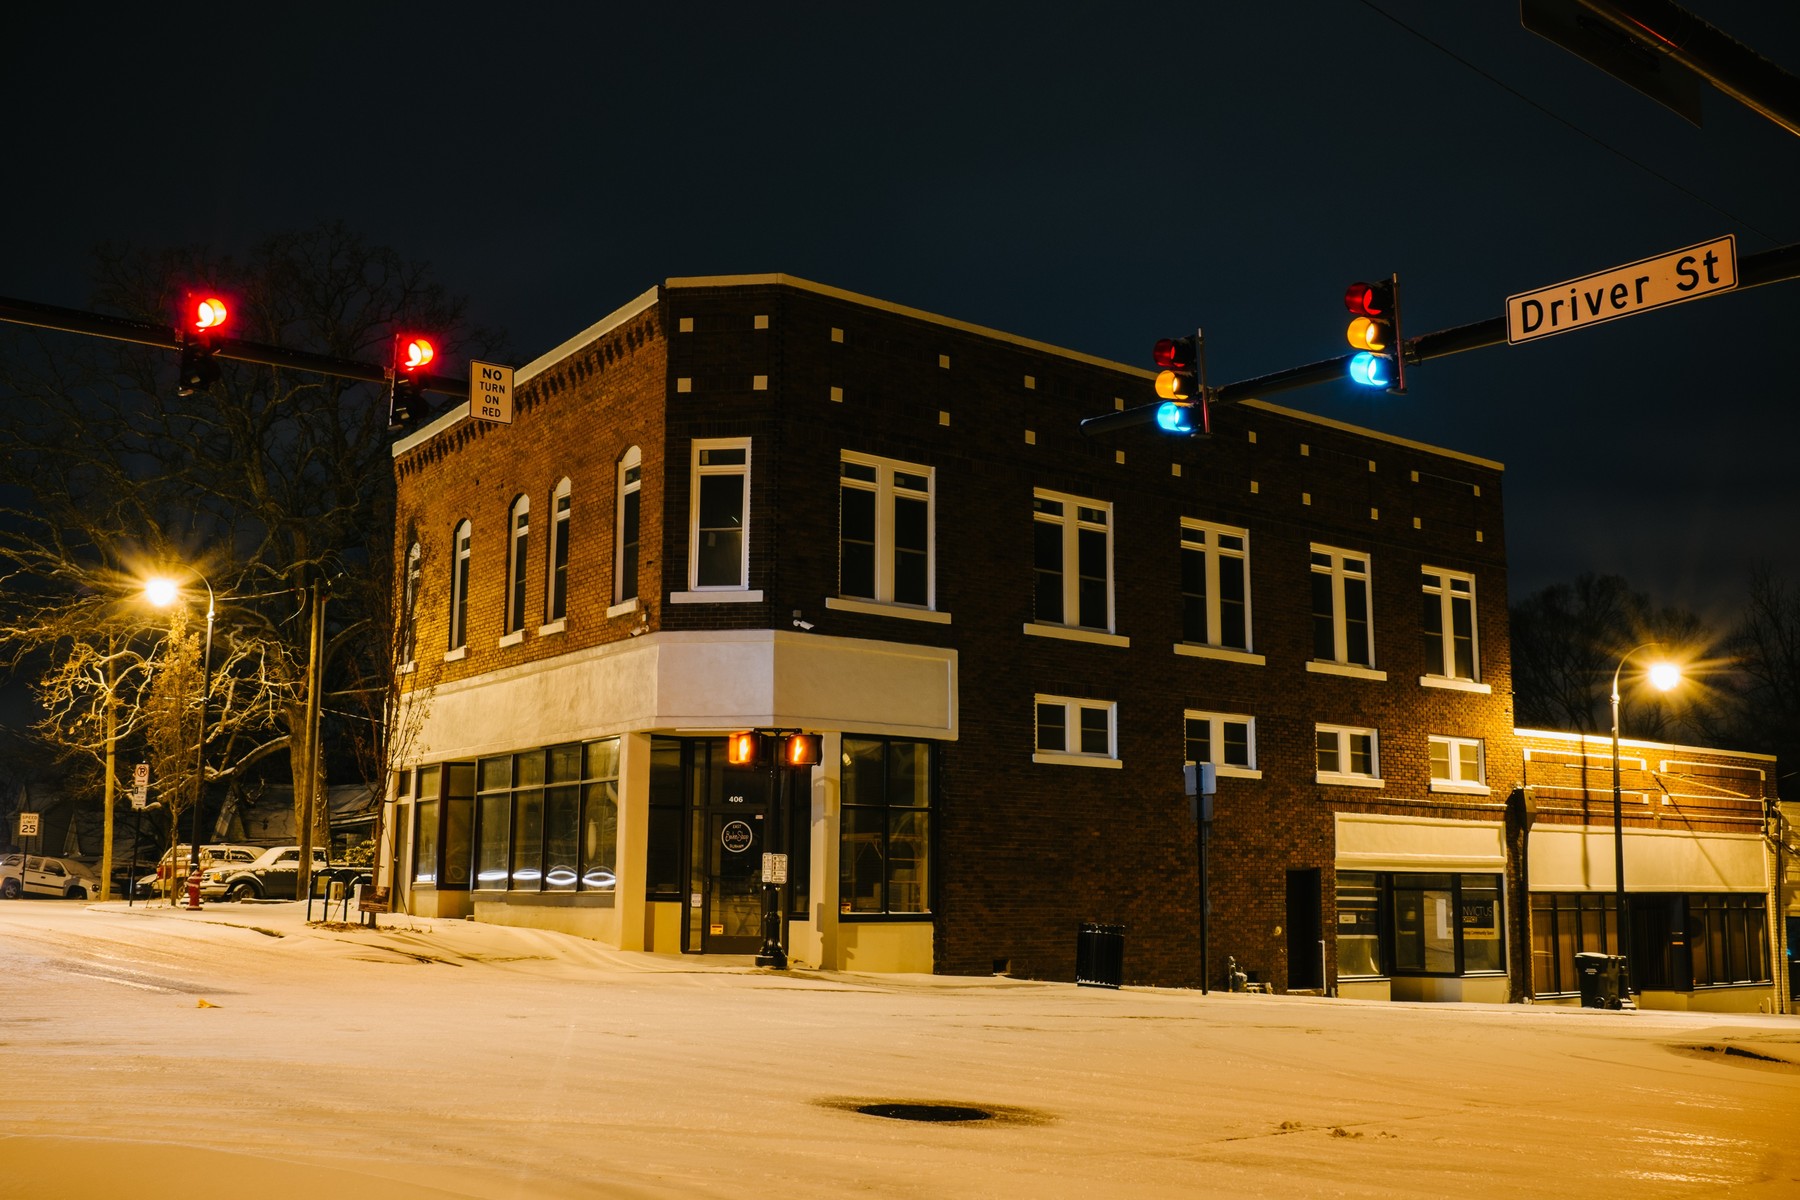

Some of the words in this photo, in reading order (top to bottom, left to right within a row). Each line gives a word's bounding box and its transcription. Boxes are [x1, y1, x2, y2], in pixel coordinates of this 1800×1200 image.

[1521, 276, 1649, 333] Driver
[1676, 250, 1719, 291] St
[483, 368, 502, 381] NO
[480, 381, 505, 394] TURN
[485, 395, 499, 405] ON
[482, 407, 501, 417] RED
[22, 825, 36, 833] 25
[1462, 906, 1492, 916] NVICTUS
